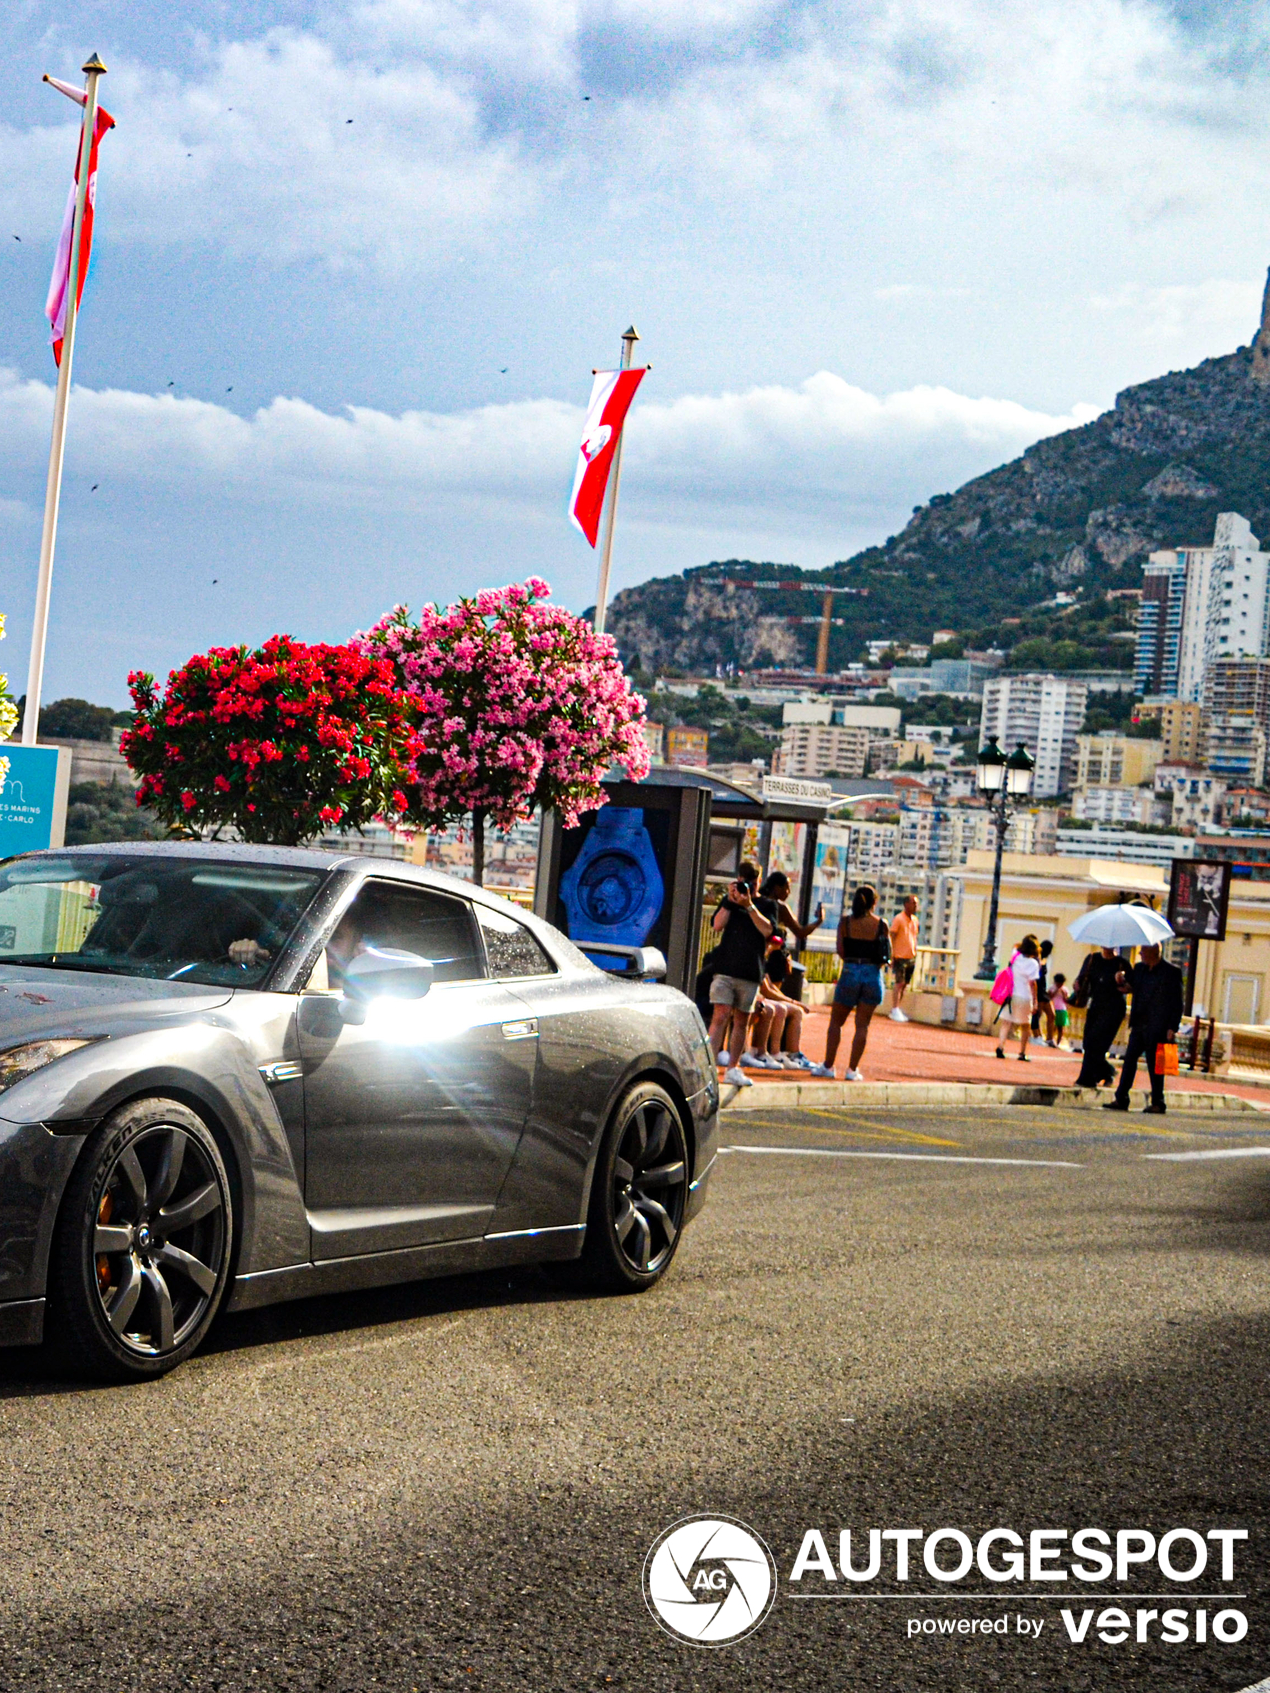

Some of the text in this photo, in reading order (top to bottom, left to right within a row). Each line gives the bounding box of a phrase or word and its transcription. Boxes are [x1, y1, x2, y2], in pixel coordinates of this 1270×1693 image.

[764, 780, 830, 799] TERRASSES DU CASINO
[11, 805, 41, 815] MARINS
